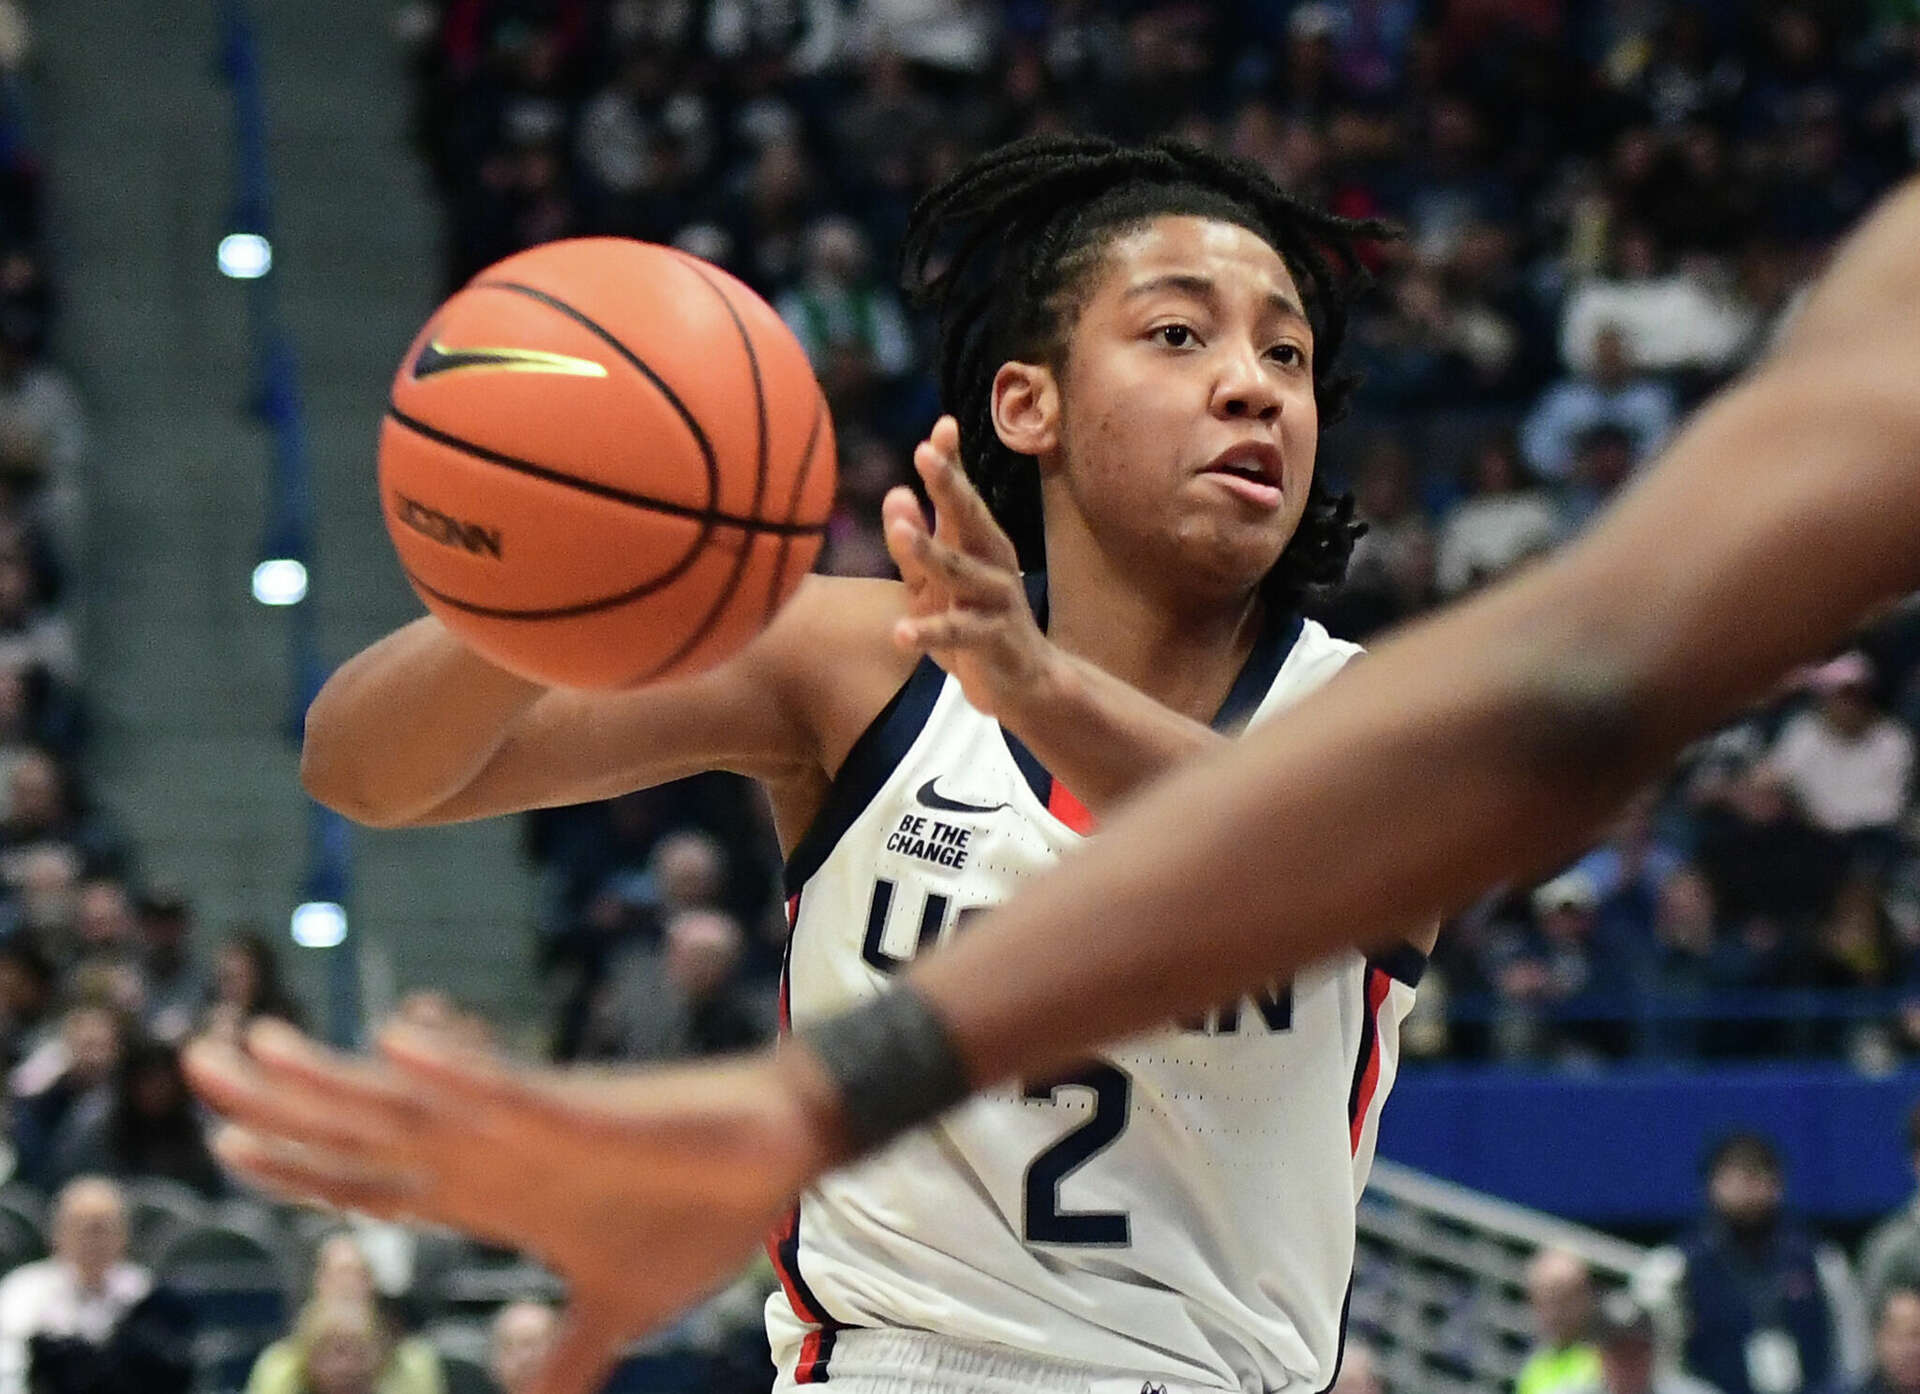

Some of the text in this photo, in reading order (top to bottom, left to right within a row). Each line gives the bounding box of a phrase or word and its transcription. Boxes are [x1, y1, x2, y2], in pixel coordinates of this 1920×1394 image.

[899, 814, 971, 848] BE THE
[886, 832, 968, 869] CHANGE
[1020, 1057, 1133, 1248] 2
